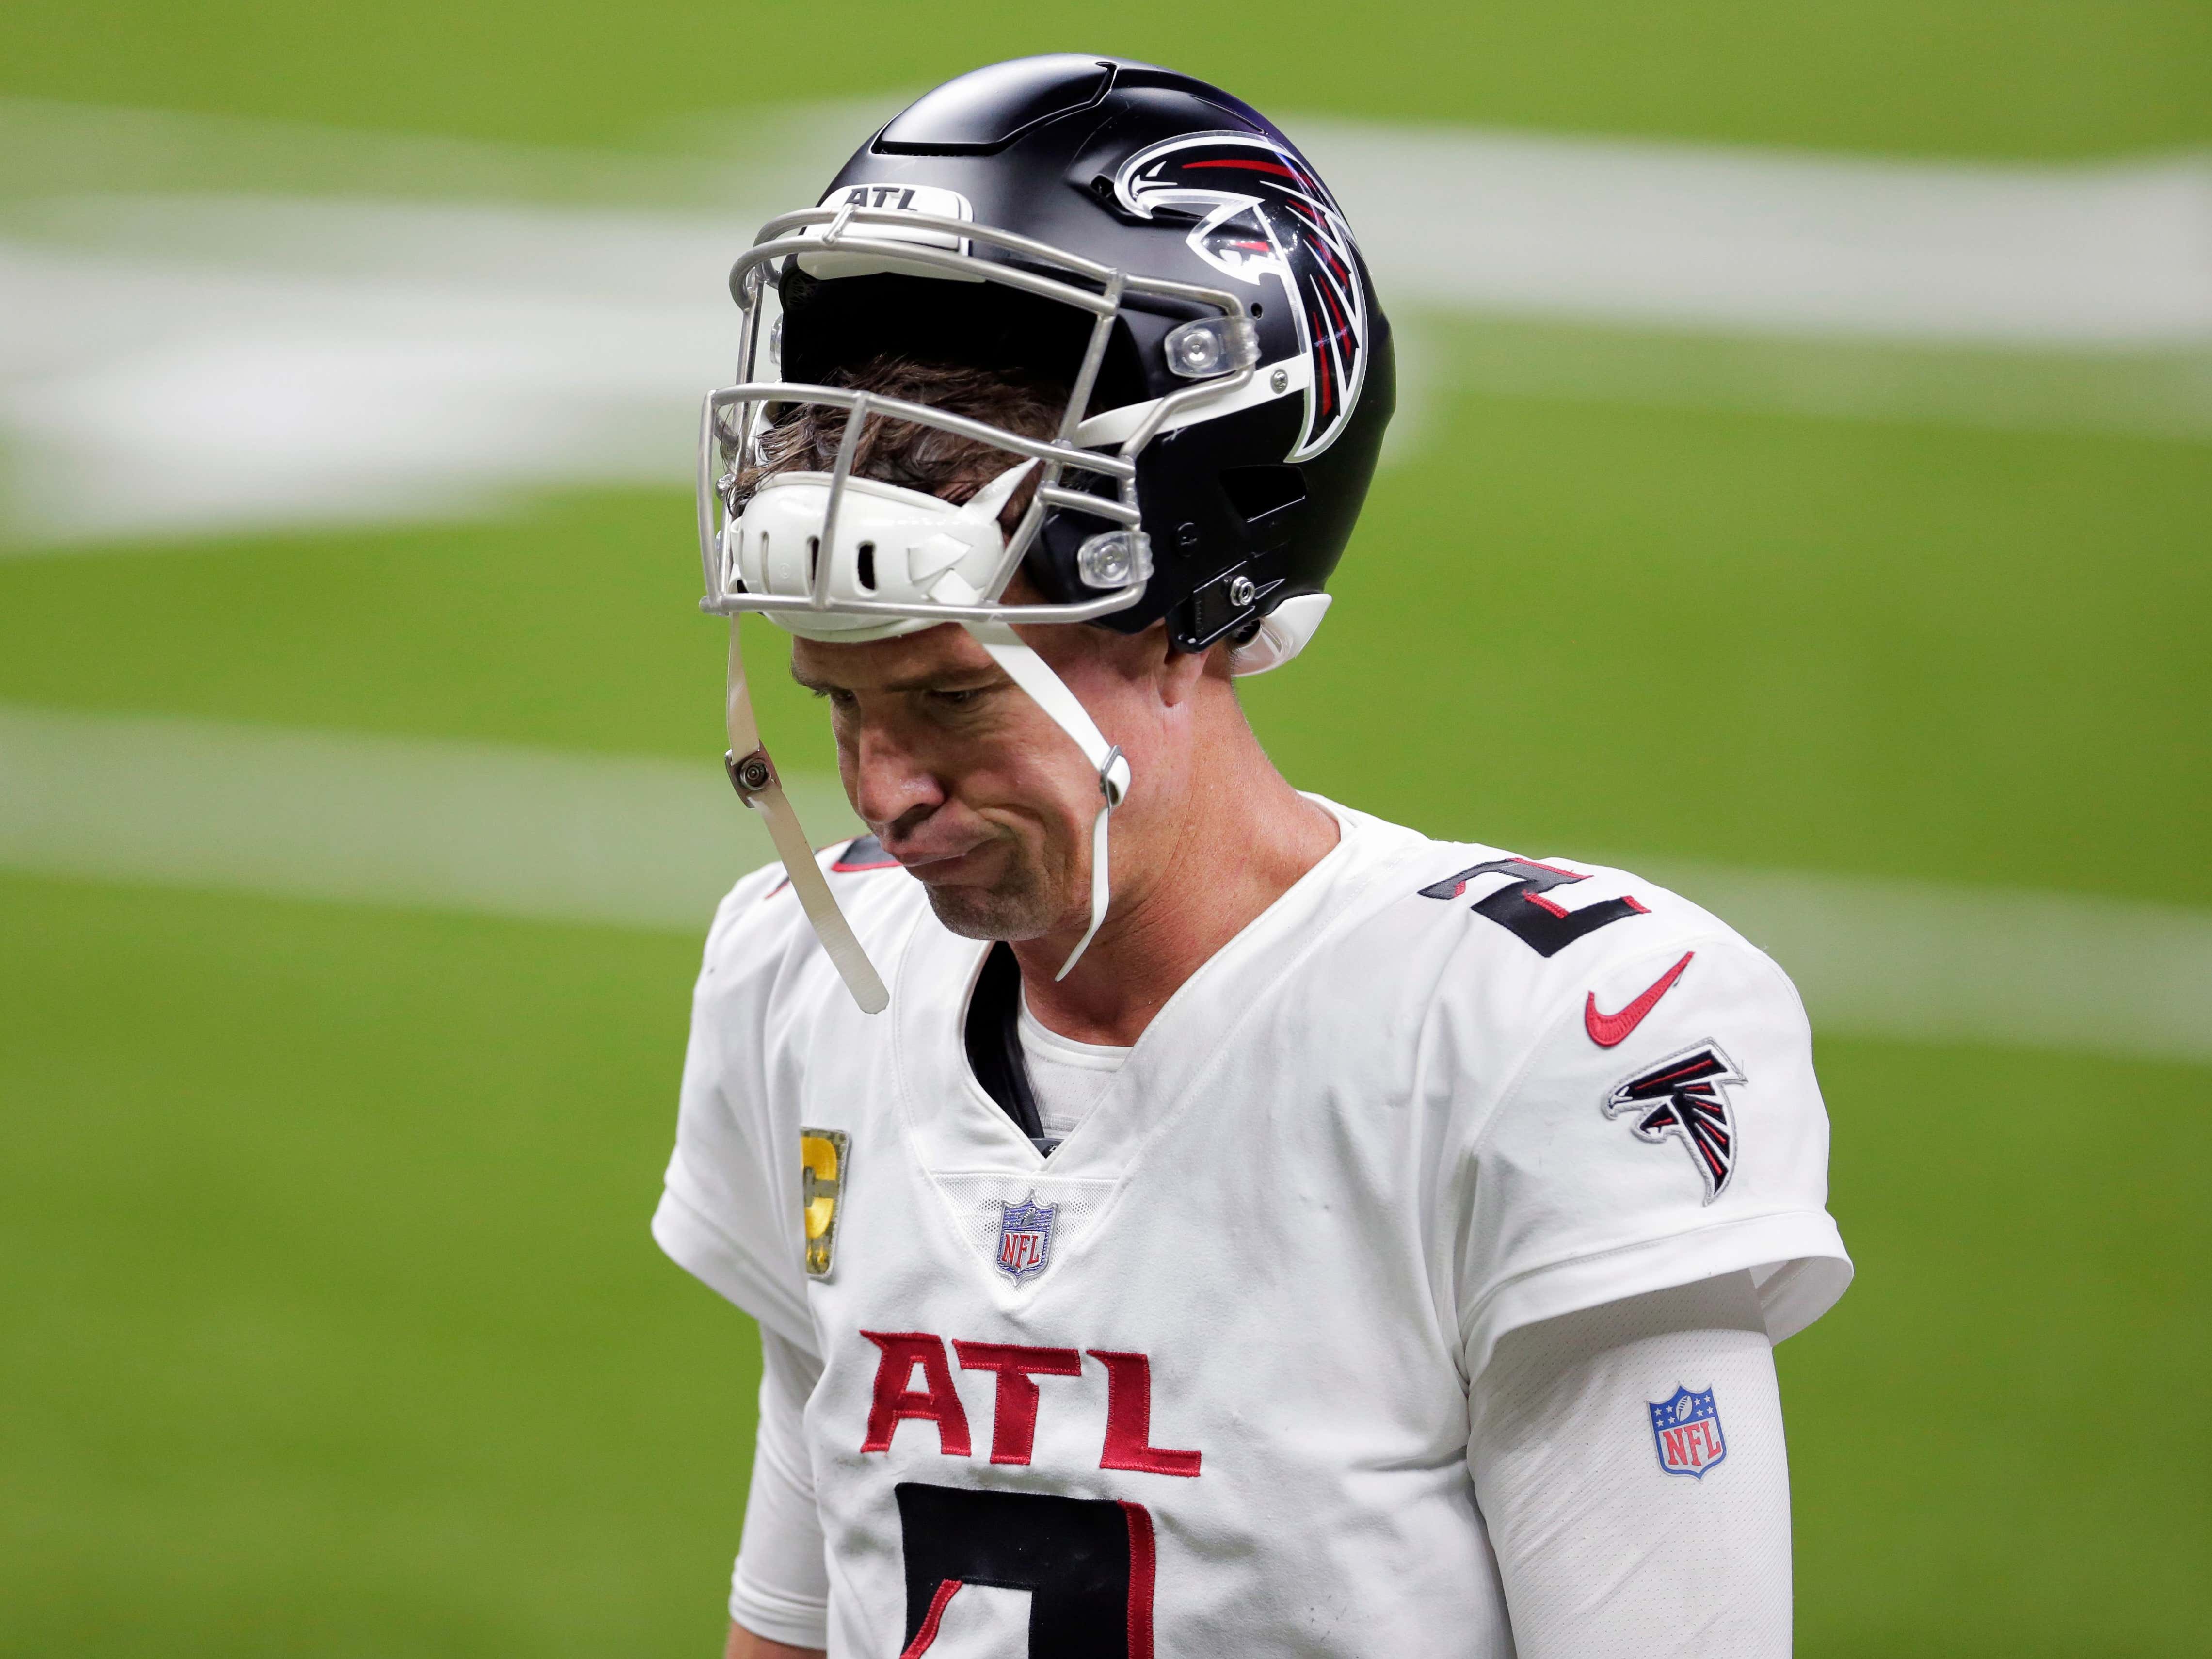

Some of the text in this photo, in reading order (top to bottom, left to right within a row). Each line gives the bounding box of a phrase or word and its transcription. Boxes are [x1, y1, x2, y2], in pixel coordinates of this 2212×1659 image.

[845, 187, 918, 211] ATL
[1417, 857, 1652, 958] 2
[1001, 1234, 1041, 1268] NFL
[859, 1329, 1202, 1477] ATL
[1662, 1420, 1722, 1466] NFL
